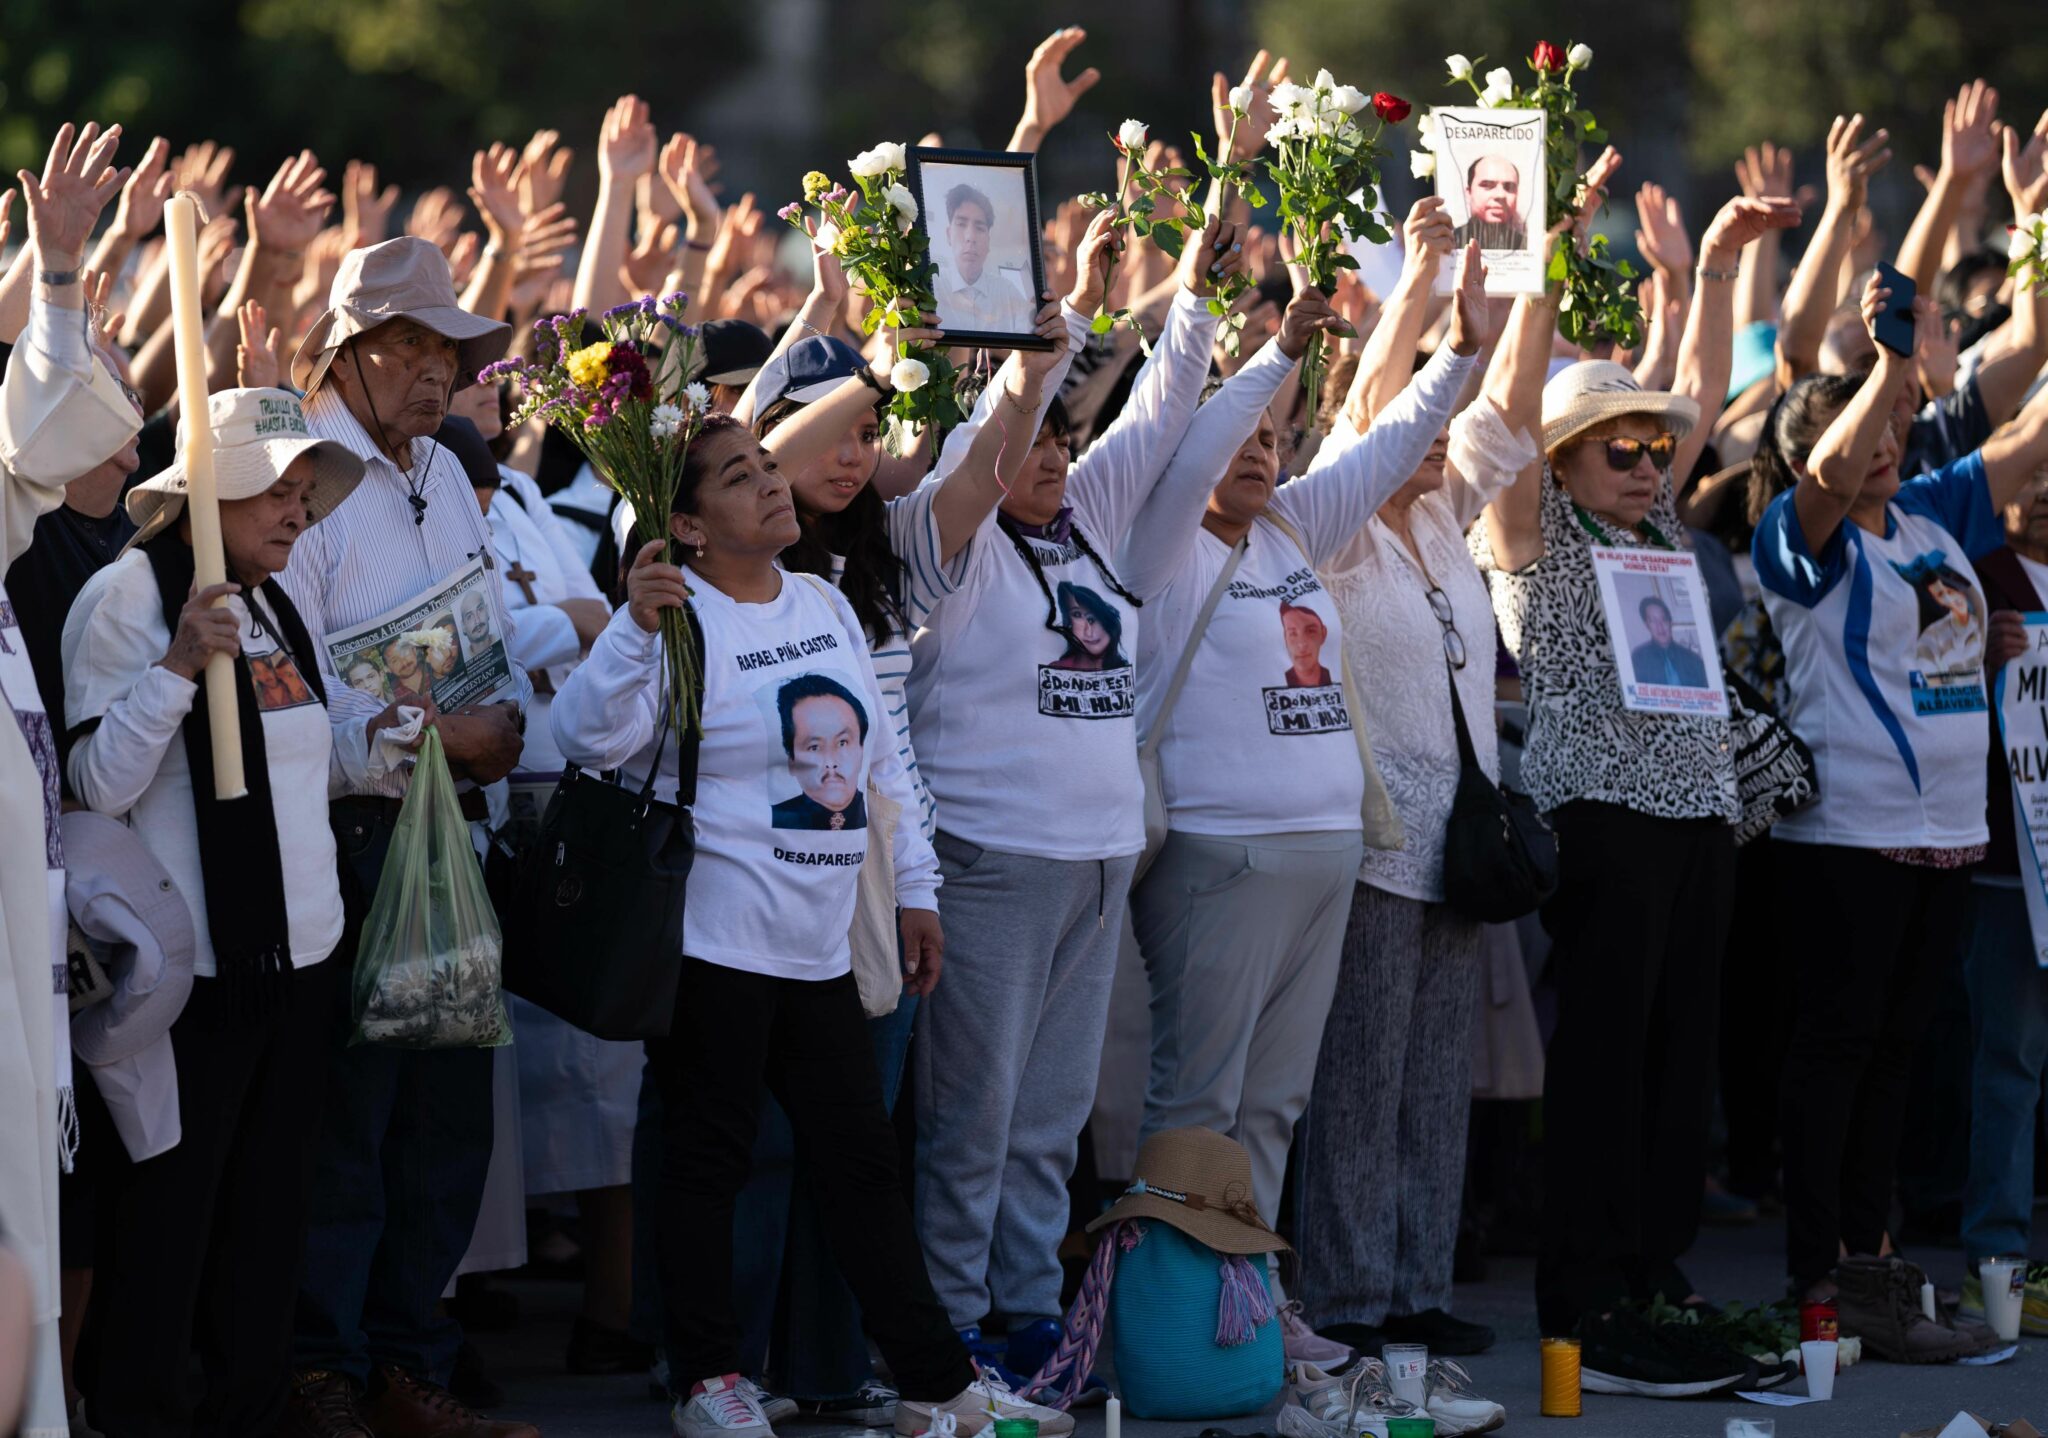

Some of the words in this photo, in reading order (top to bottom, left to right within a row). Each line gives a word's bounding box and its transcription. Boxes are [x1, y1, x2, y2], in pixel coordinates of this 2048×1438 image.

[1445, 127, 1534, 140] DESAPARECIDO
[332, 632, 379, 655] Buscamos
[381, 627, 389, 638] A
[388, 606, 430, 633] Hermanos
[428, 589, 457, 612] Trujillo
[456, 570, 483, 594] Herrera
[736, 650, 778, 671] RAFAEL
[776, 642, 803, 662] PIÑA
[800, 633, 838, 655] CASTRO
[1053, 694, 1081, 713] MI
[1281, 712, 1311, 729] MI
